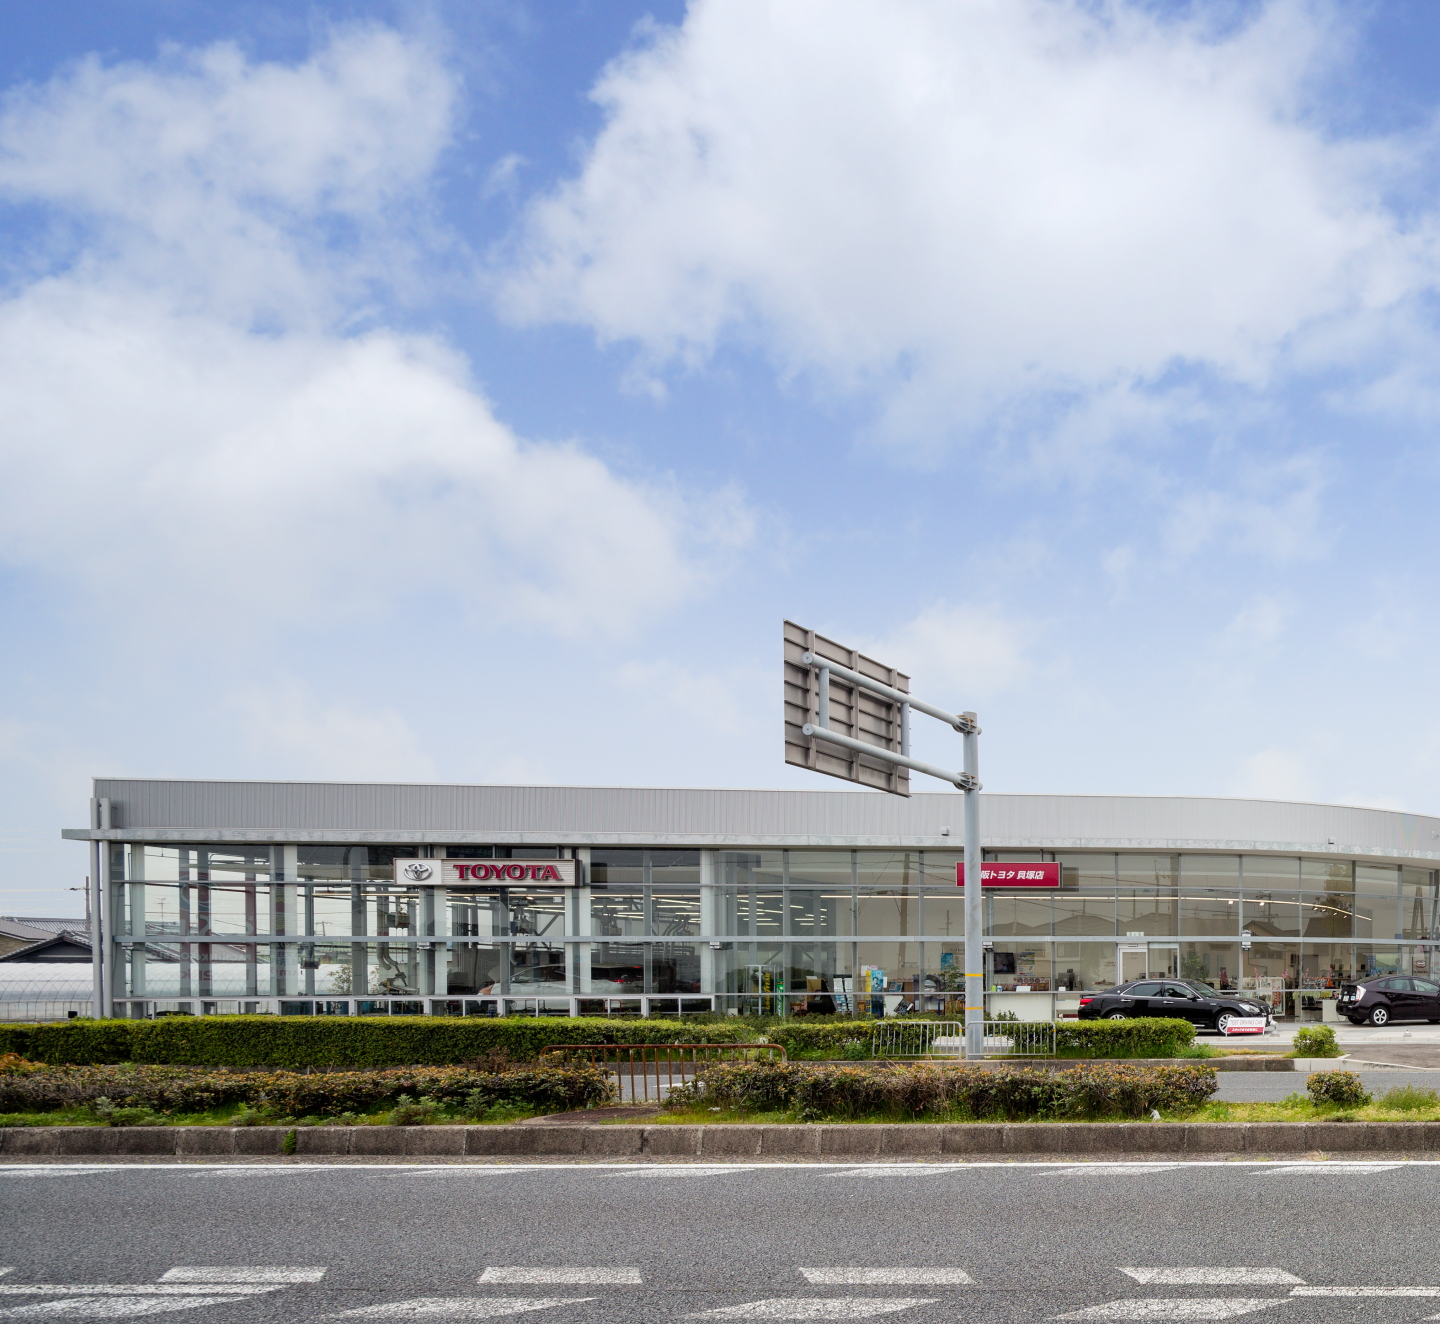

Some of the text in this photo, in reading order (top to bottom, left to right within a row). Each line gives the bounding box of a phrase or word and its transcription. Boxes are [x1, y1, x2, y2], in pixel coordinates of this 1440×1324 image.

[453, 864, 563, 880] TOYOTA
[981, 870, 1045, 880] 阪トヨタ 貝塚店
